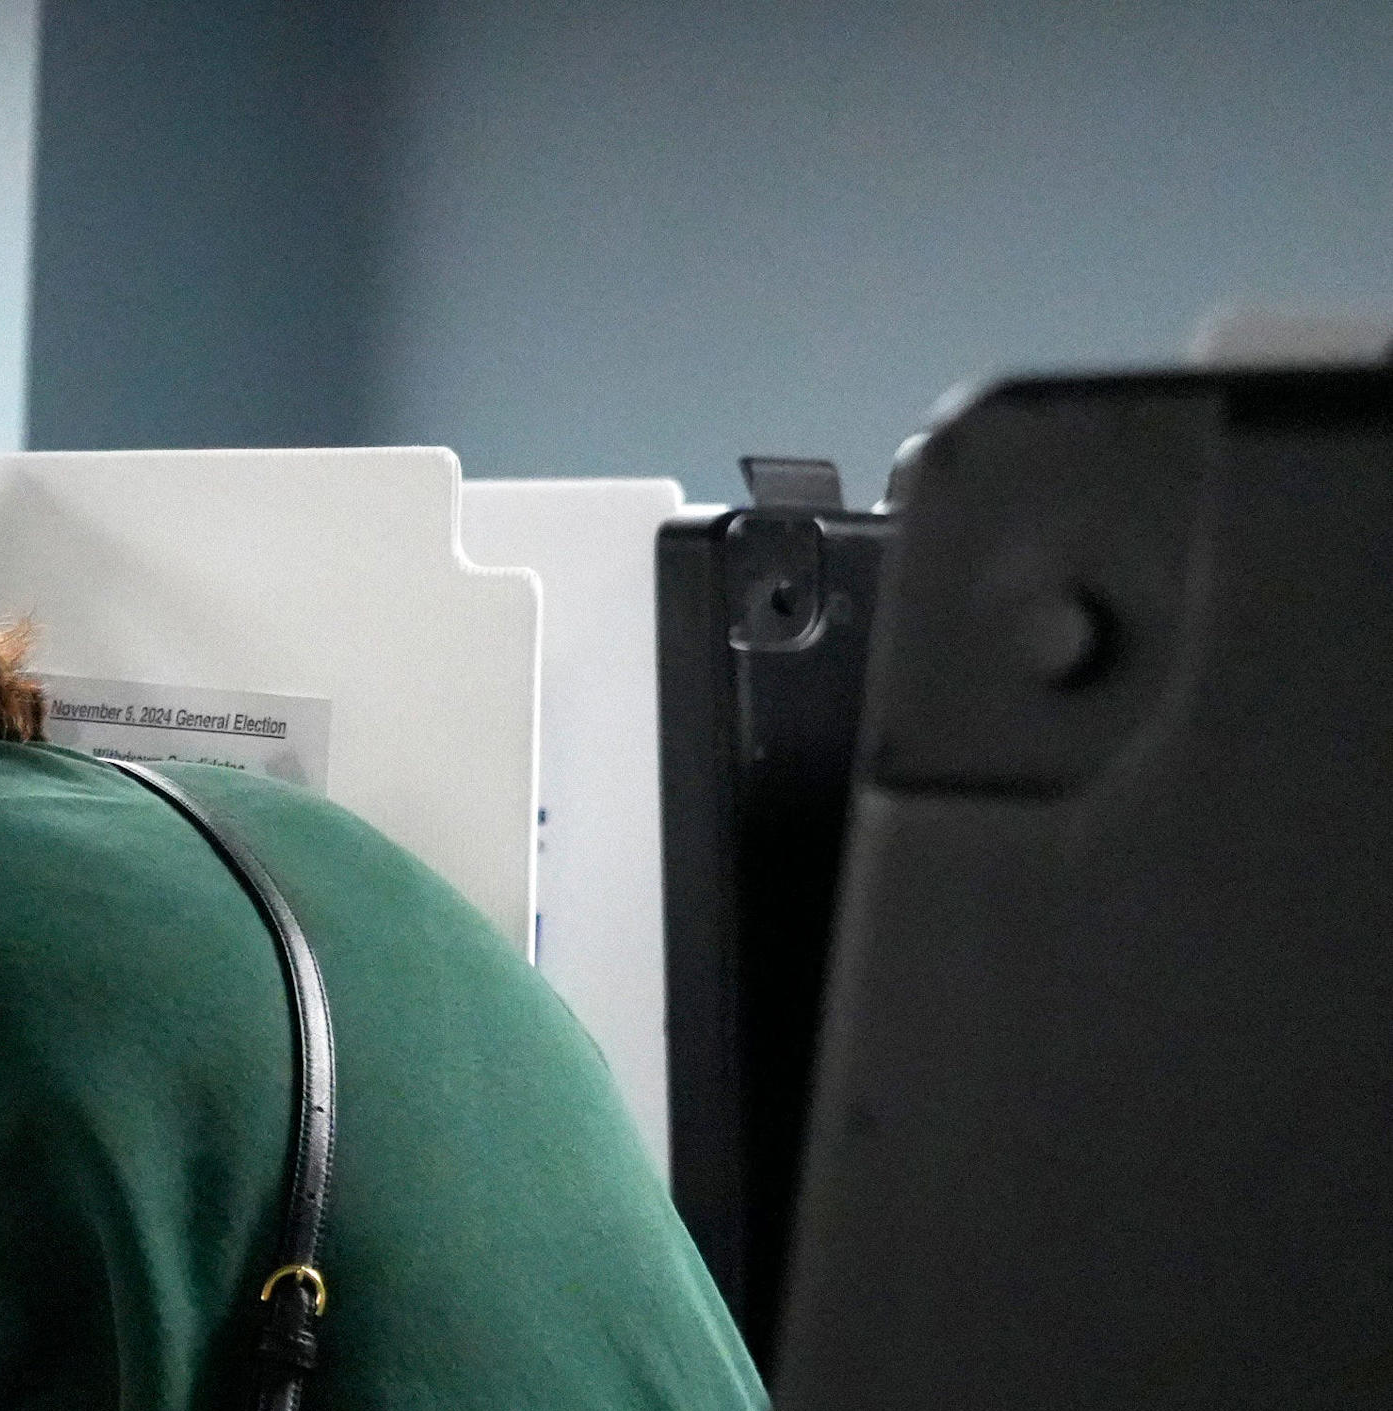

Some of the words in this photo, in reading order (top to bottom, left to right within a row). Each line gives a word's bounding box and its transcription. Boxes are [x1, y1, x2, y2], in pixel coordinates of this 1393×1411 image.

[51, 699, 122, 720] November
[124, 705, 136, 723] 5,
[140, 706, 173, 726] 2024
[176, 709, 230, 731] General
[233, 713, 287, 735] Election
